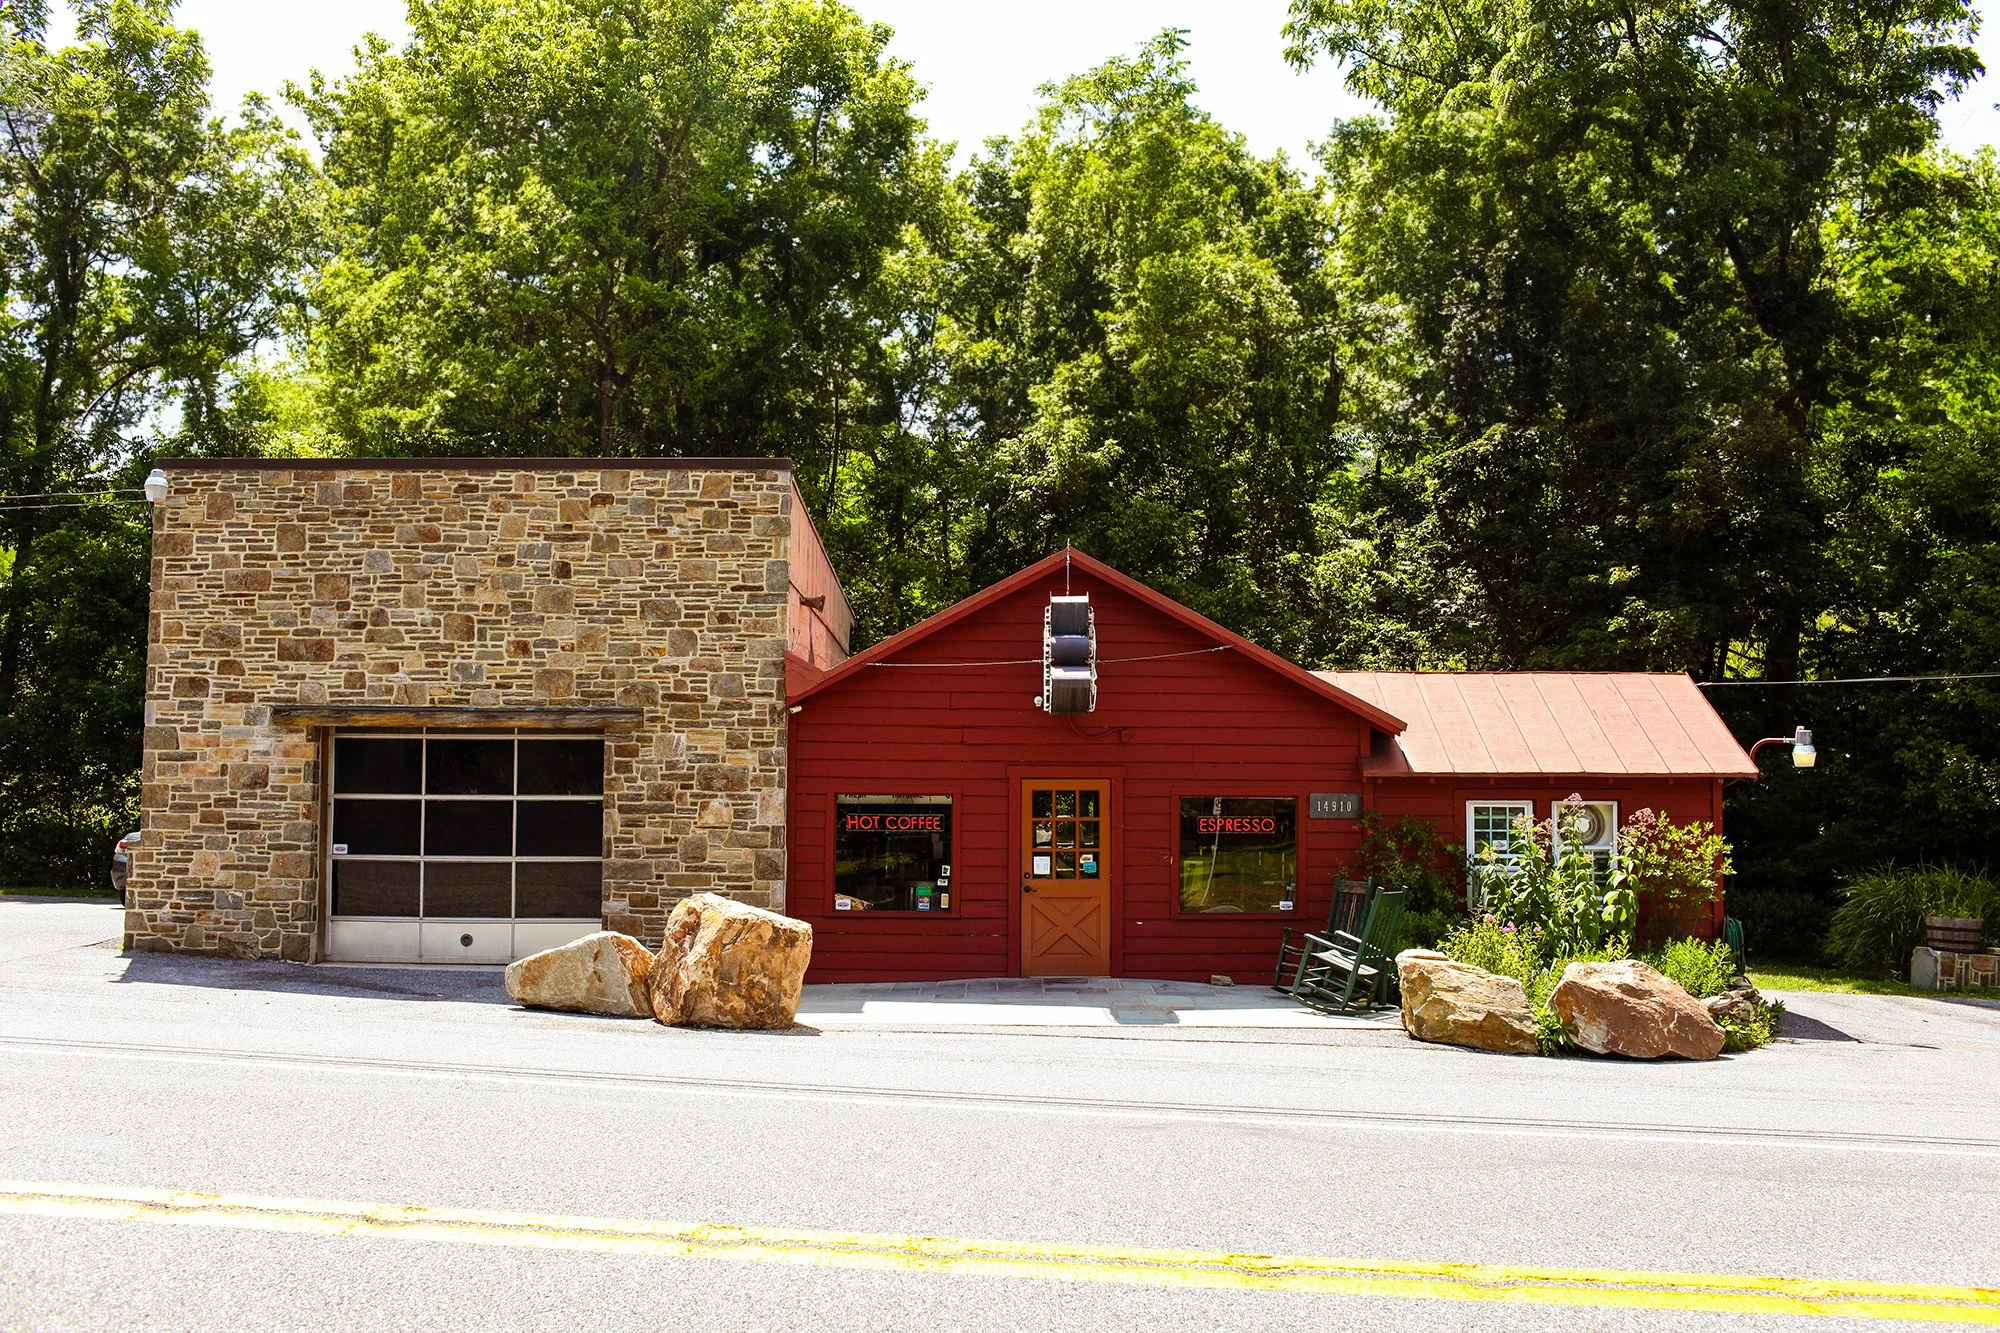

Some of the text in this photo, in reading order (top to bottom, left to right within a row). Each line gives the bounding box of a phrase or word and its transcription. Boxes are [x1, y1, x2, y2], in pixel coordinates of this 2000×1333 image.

[1317, 800, 1352, 812] 14910
[847, 815, 941, 830] HOT COFFEE
[1199, 818, 1275, 832] ESPRESSO
